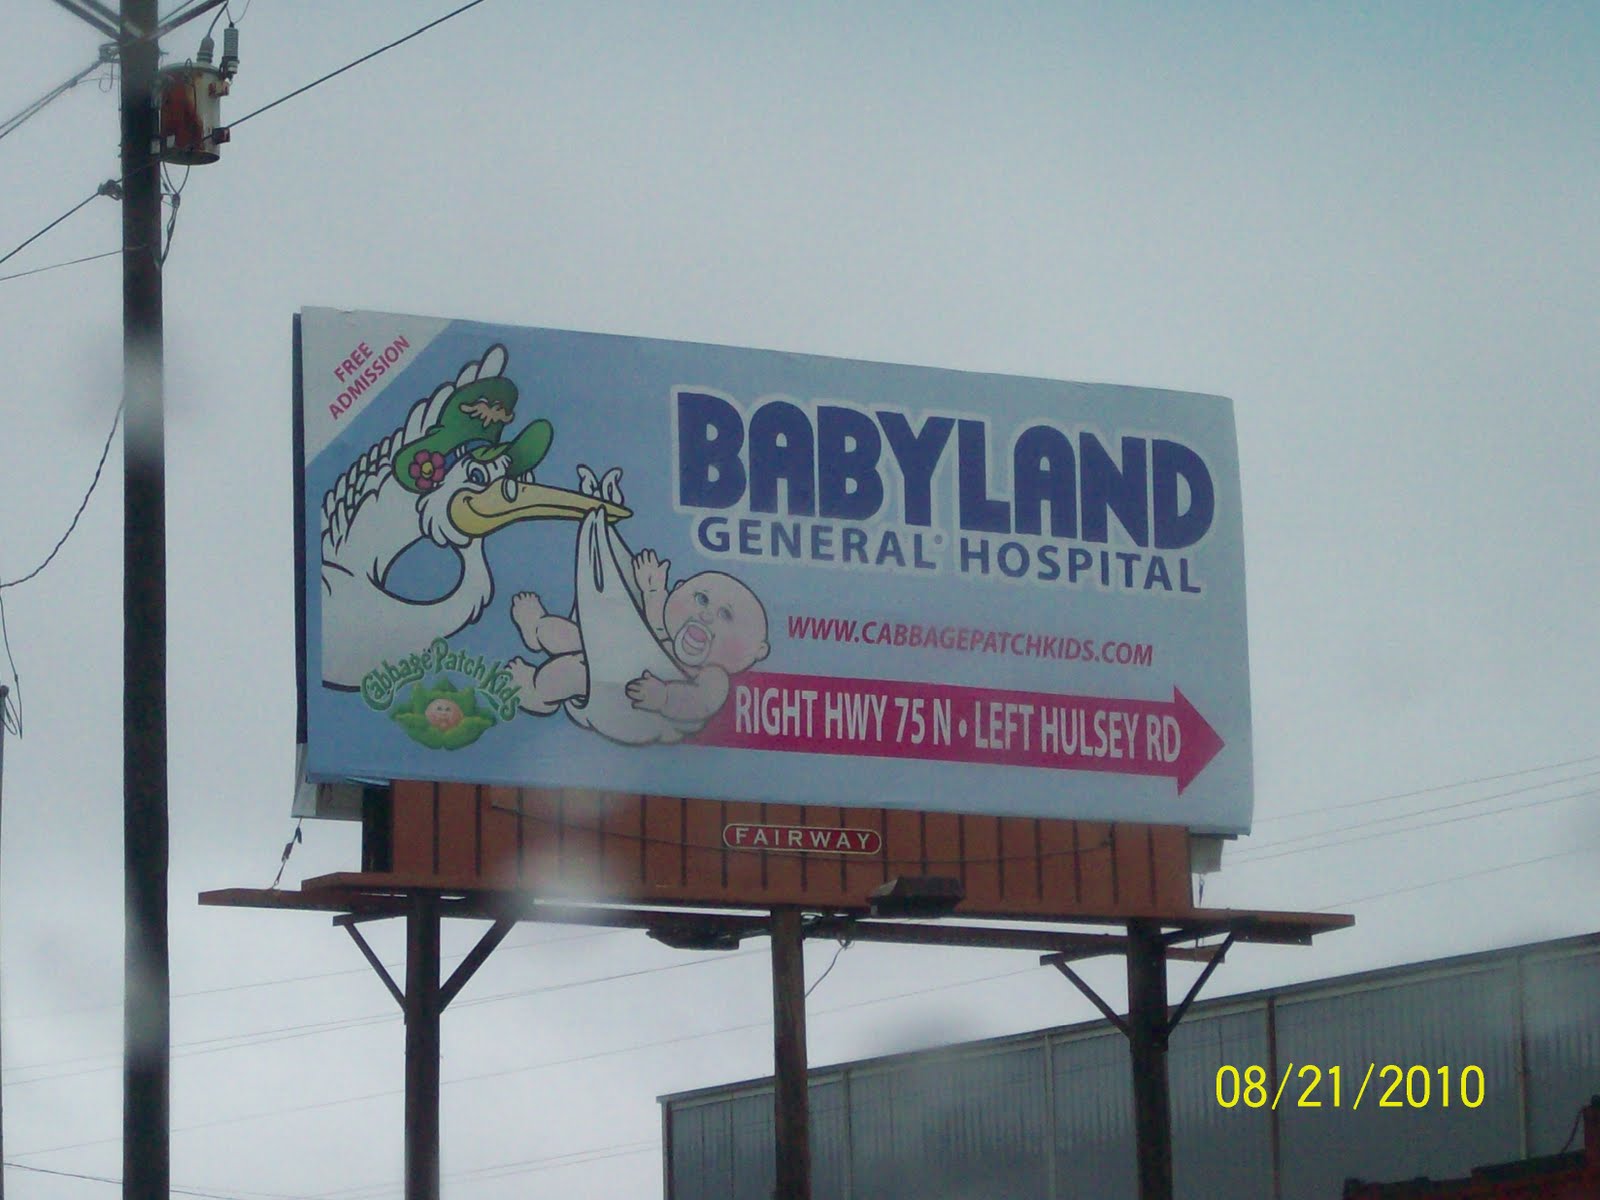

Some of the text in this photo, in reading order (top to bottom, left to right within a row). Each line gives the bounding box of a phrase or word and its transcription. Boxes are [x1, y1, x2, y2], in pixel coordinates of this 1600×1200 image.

[327, 335, 411, 420] ADMISSION
[333, 341, 374, 383] FREE
[677, 391, 1215, 550] BABYLAND
[960, 537, 1201, 593] HOSPITAL
[788, 615, 1153, 667] WWW.CABBAGEPATCHKIDS.COM
[360, 637, 522, 722] Cabbage Patch Kids
[735, 685, 1182, 763] RIGHT HWY 75 N LEFT HULSEY RD
[735, 827, 871, 850] FAIRWAY
